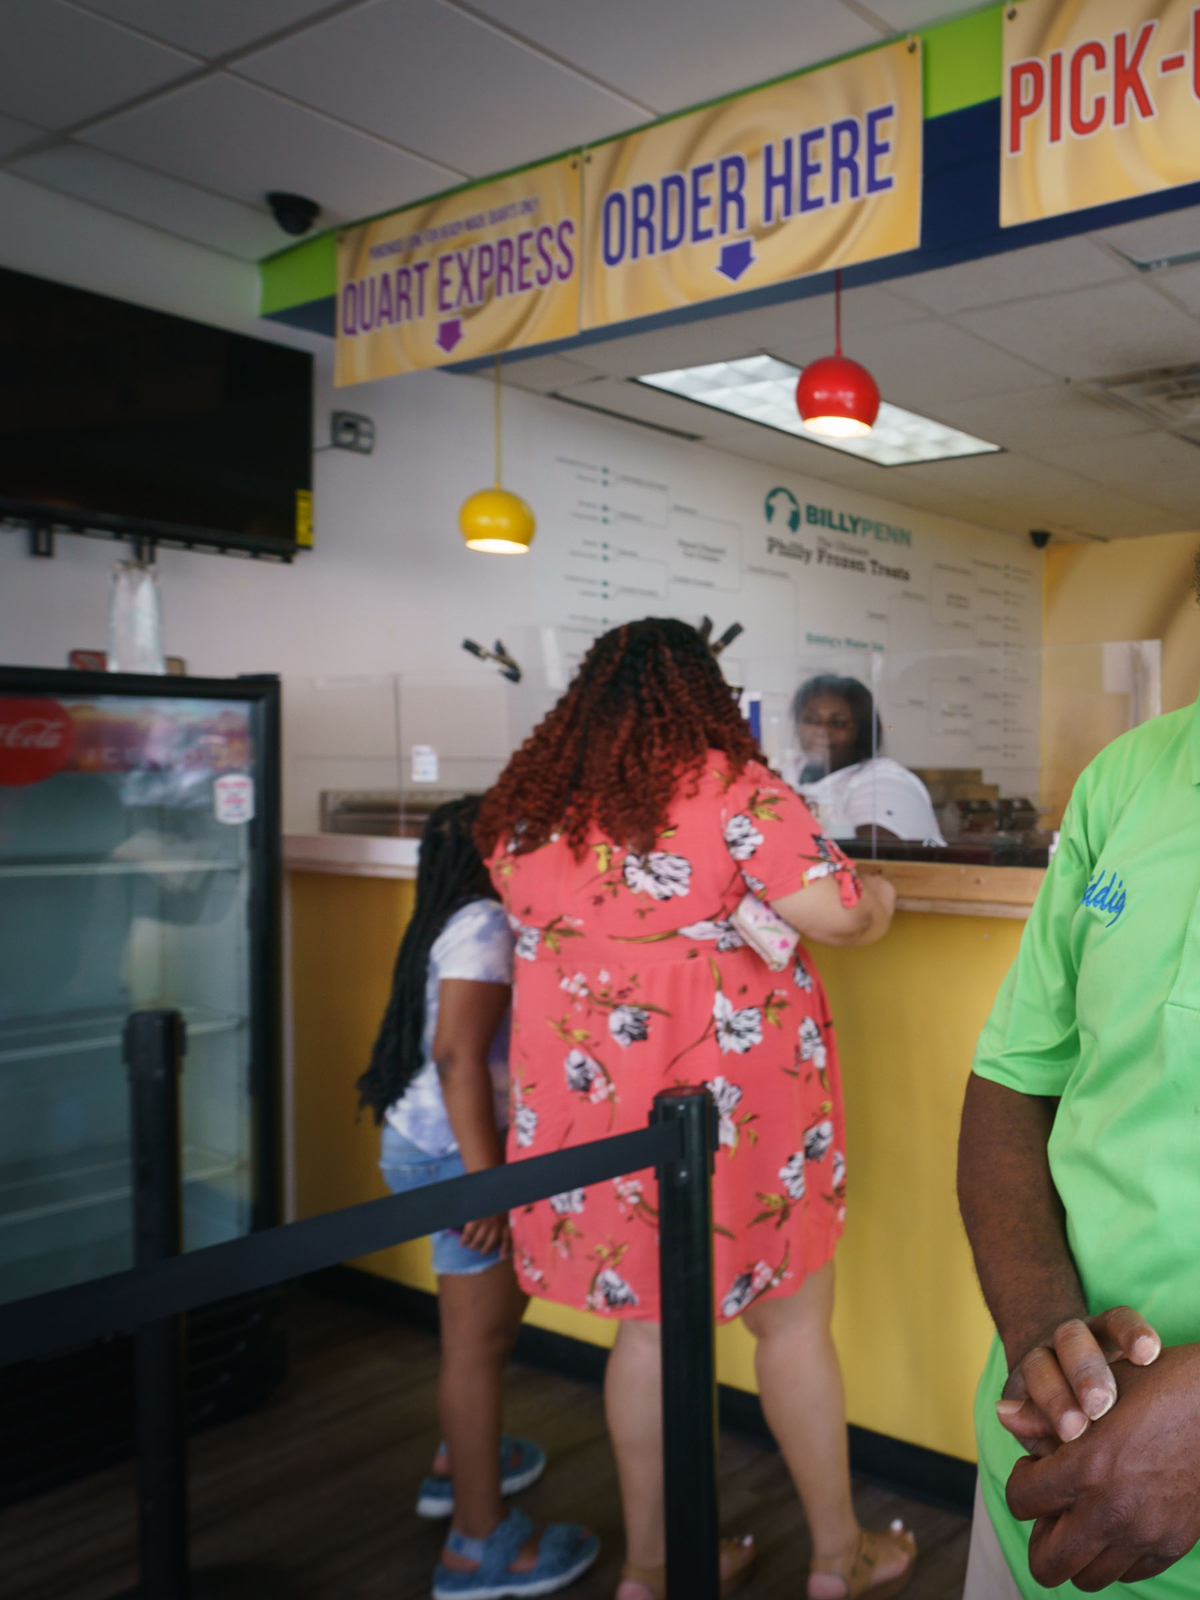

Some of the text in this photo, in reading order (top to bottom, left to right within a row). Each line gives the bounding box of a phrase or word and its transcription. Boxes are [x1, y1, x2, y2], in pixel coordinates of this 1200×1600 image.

[602, 104, 895, 267] ORDER HERE
[342, 219, 575, 336] QUART EXPRESS
[806, 504, 913, 548] BILLYPENN
[766, 535, 812, 566] Philly
[817, 547, 867, 573] Frozen
[869, 558, 911, 582] Treats
[0, 716, 64, 749] Cola
